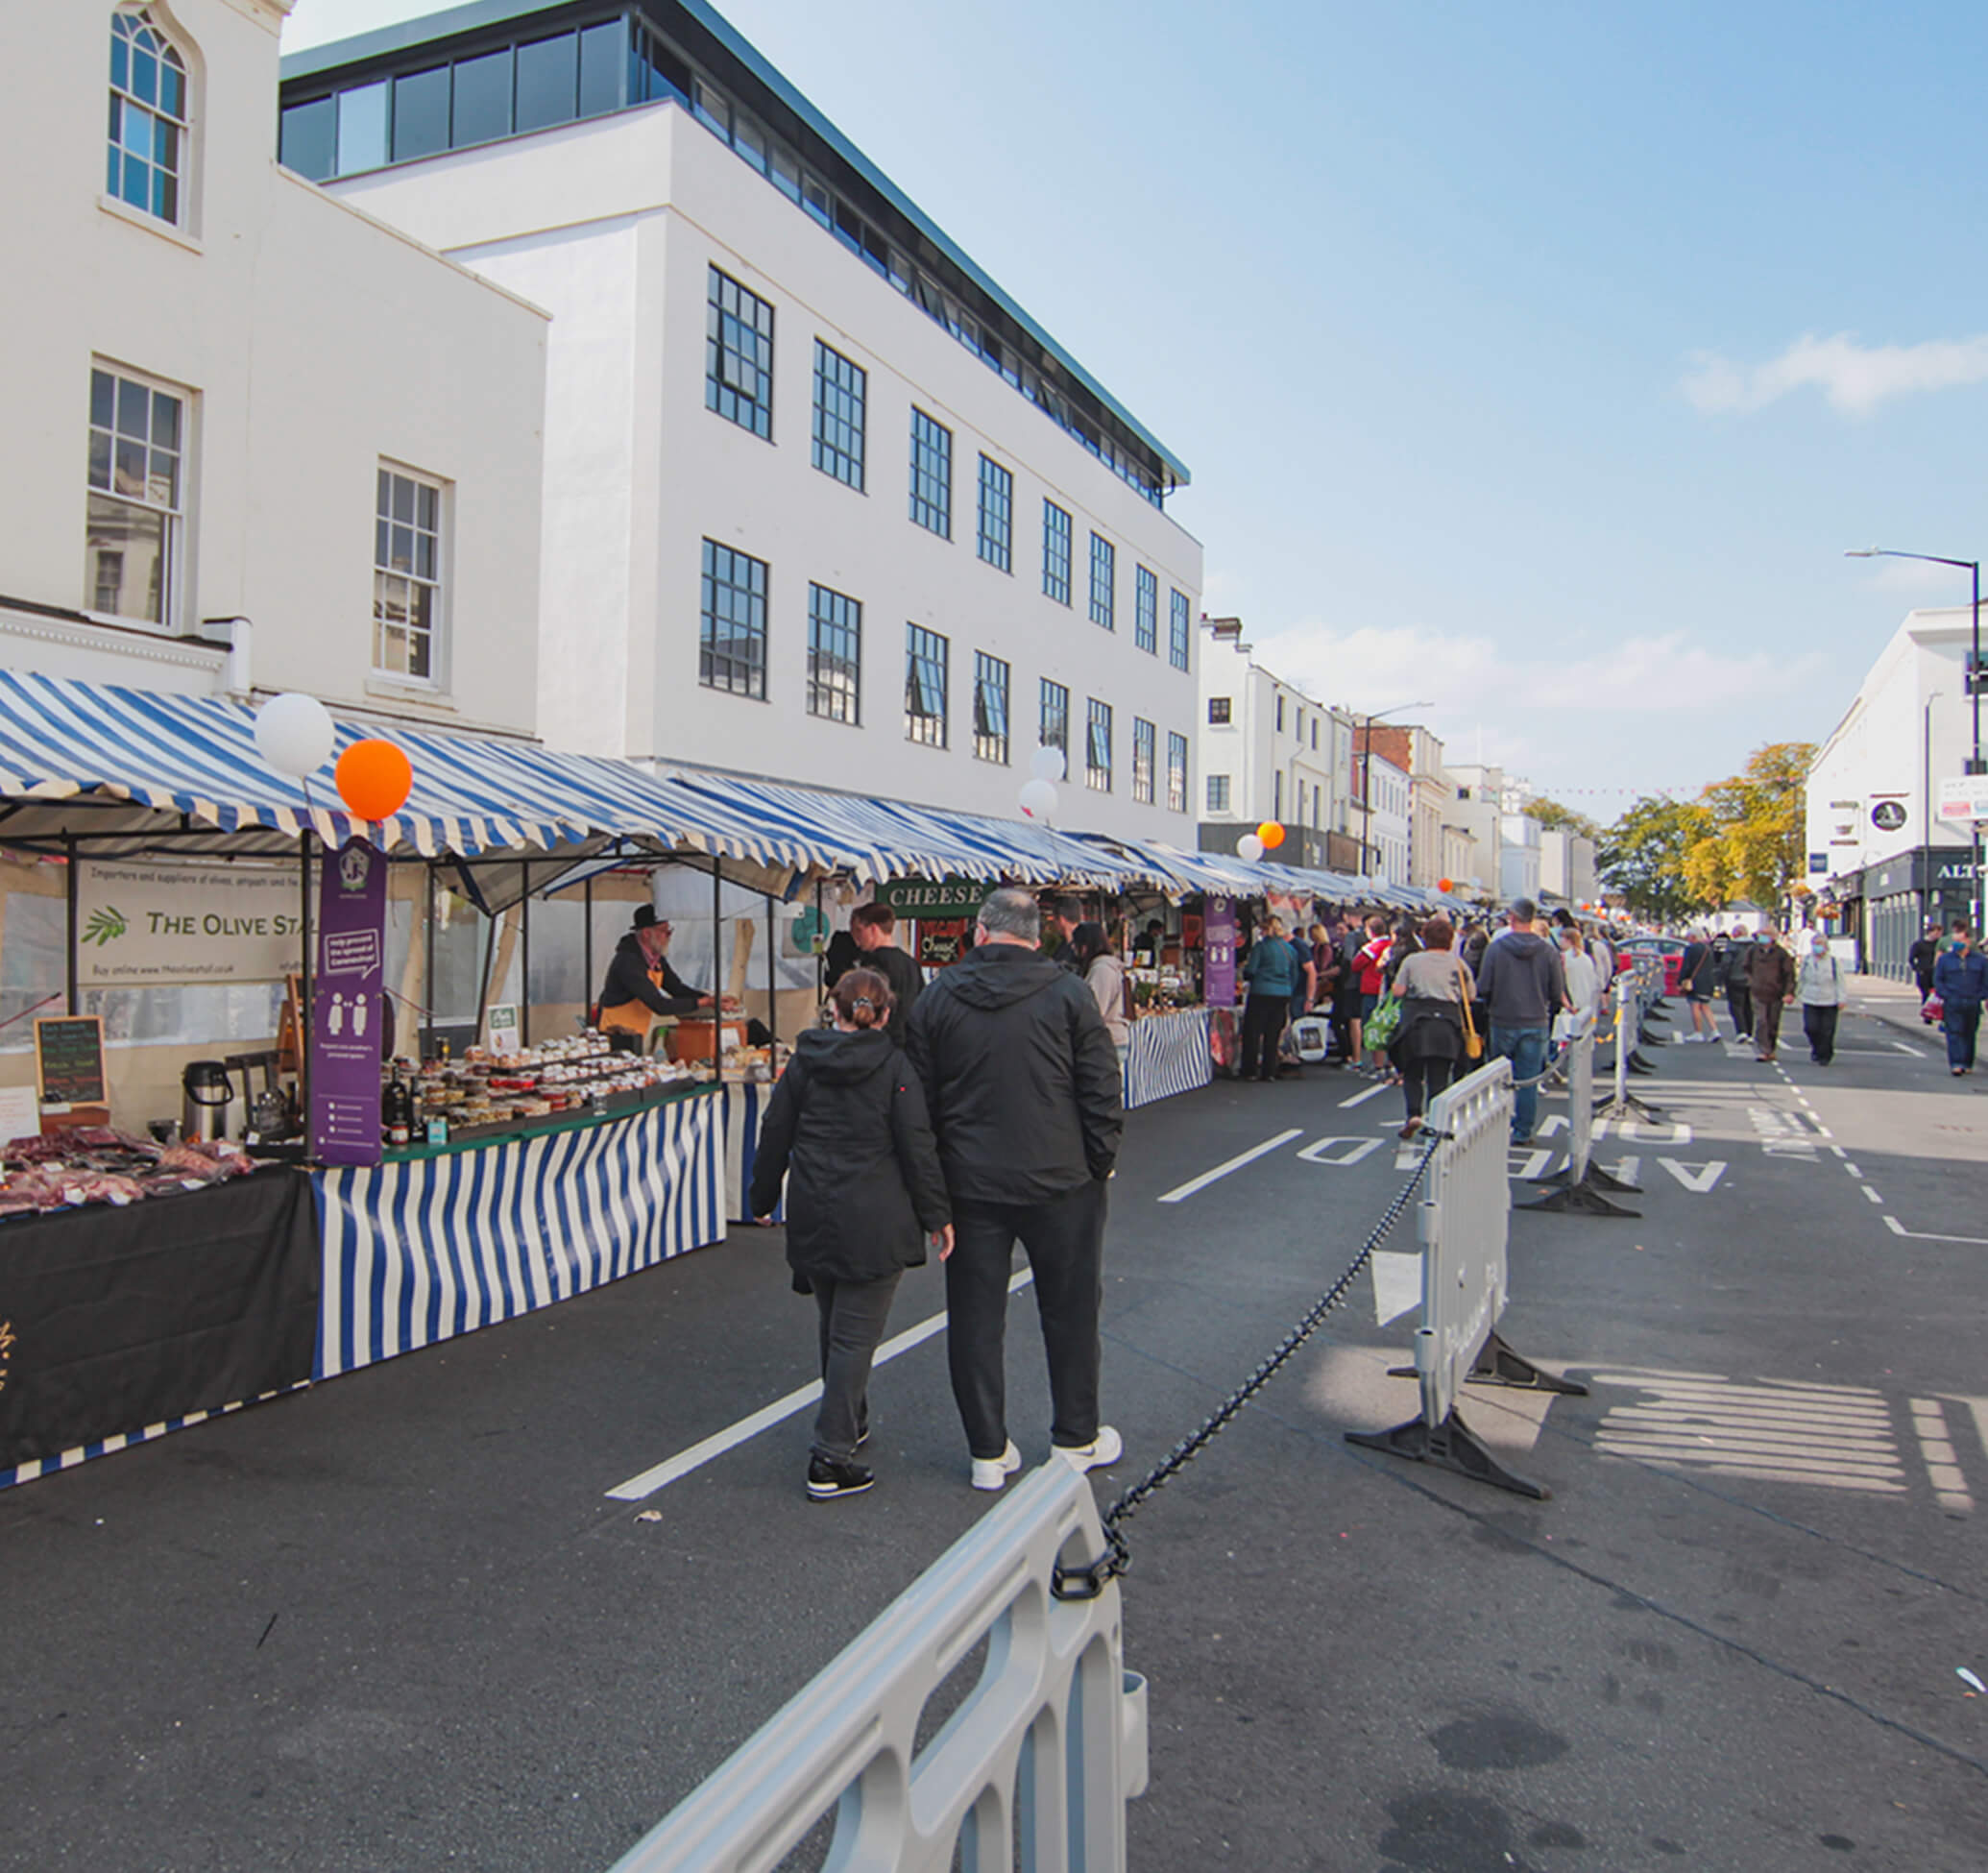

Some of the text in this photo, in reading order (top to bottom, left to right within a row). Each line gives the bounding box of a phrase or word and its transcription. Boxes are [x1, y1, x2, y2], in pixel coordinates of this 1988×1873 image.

[139, 870, 156, 881] and
[888, 886, 984, 907] CHEESE
[146, 912, 196, 935] THE
[203, 913, 268, 936] OLIVE
[93, 963, 109, 976] Buy
